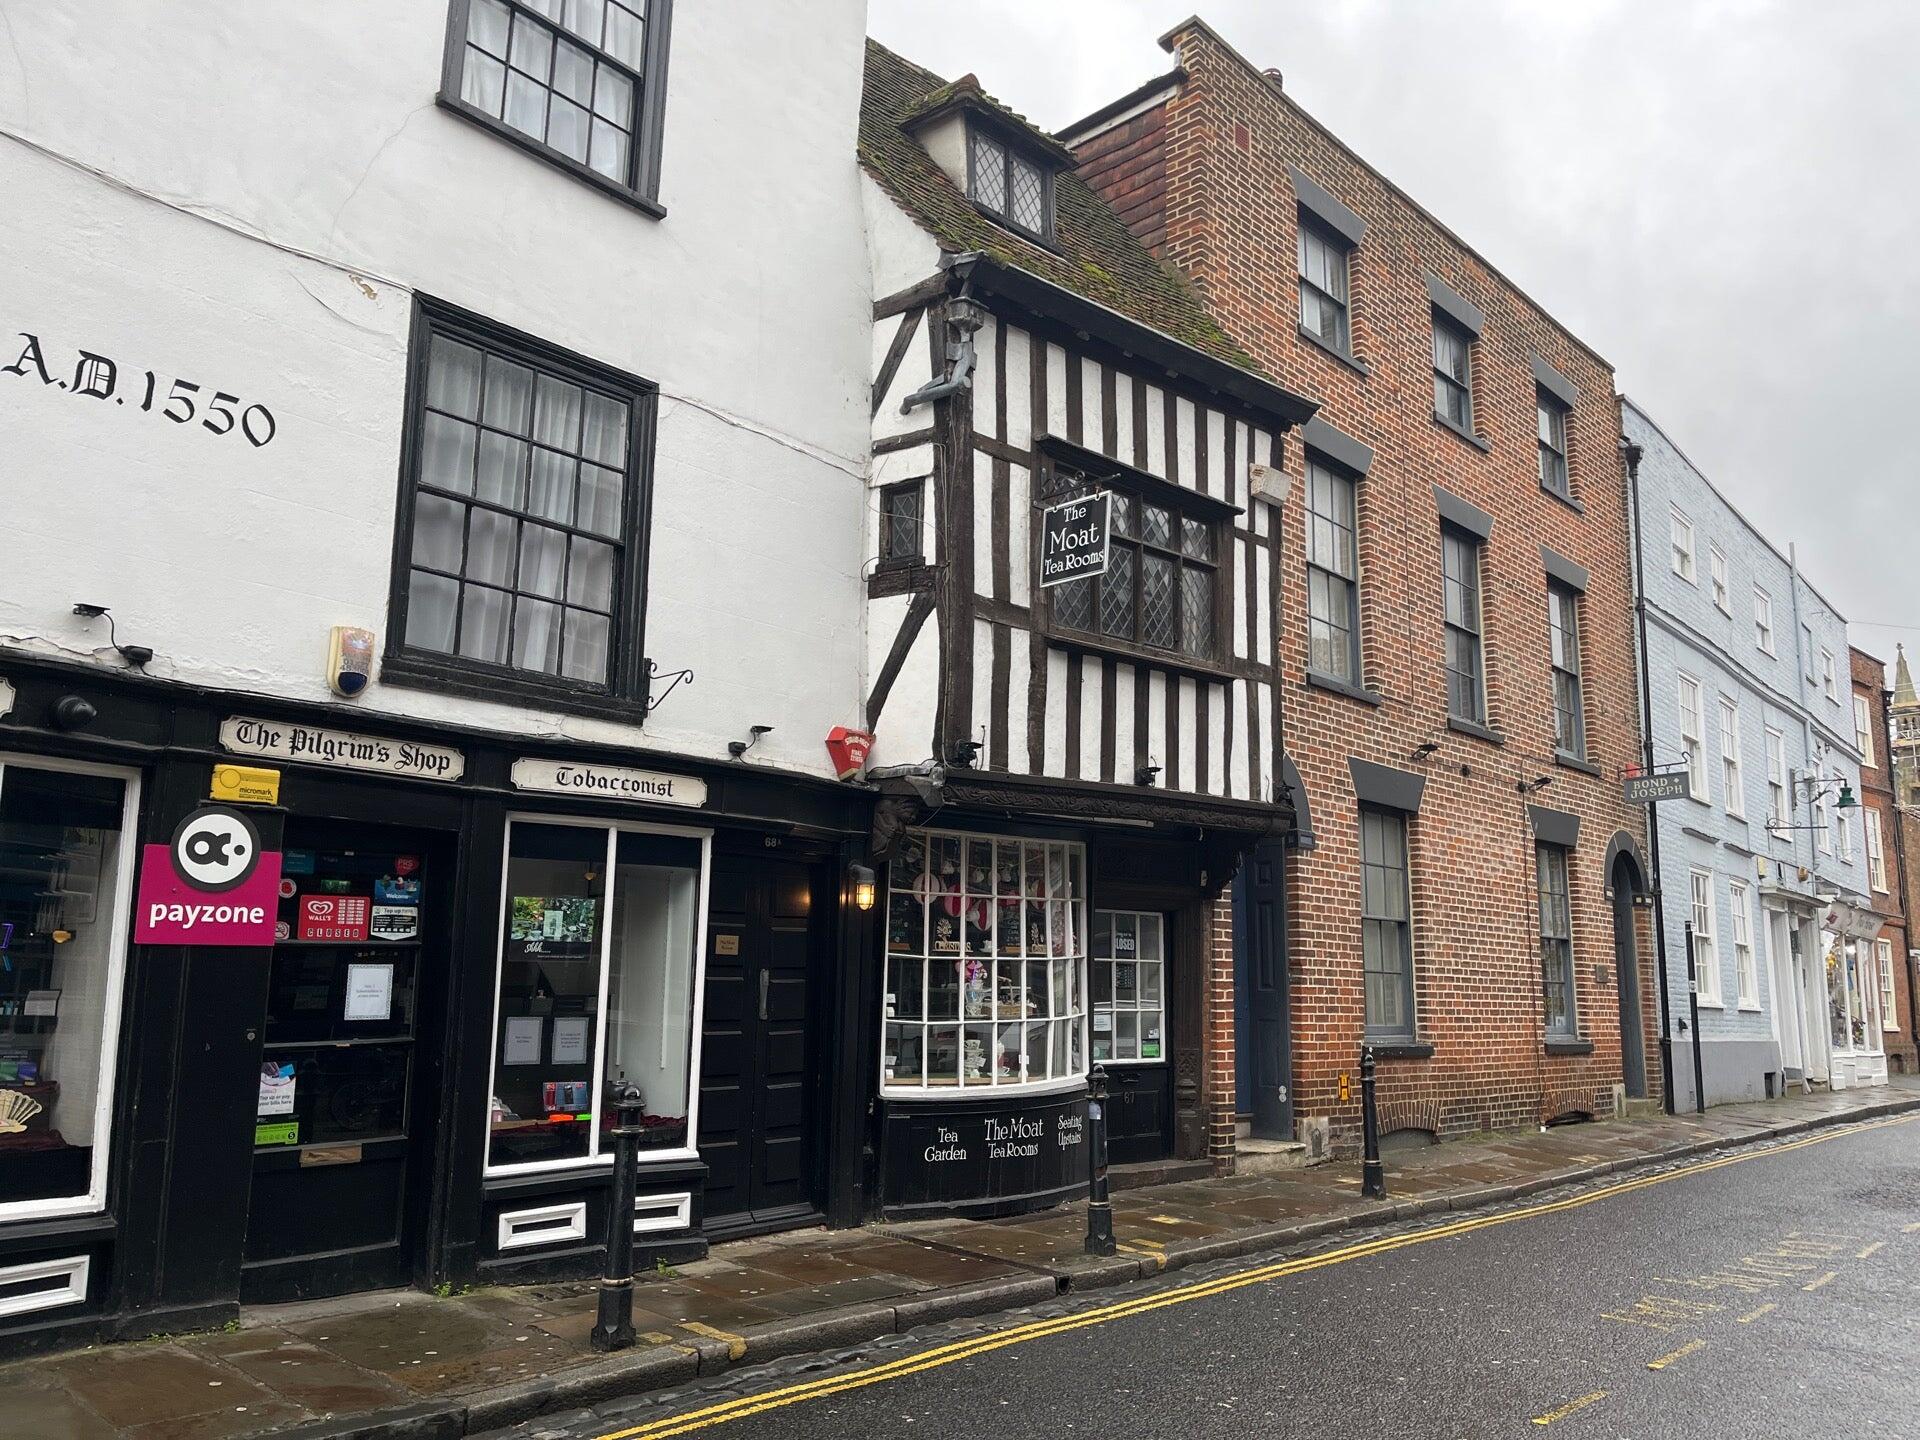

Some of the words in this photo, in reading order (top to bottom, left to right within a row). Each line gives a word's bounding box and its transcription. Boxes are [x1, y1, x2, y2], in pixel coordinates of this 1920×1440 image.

[141, 371, 276, 447] 1550
[1063, 506, 1087, 523] The
[1049, 522, 1100, 555] Moat
[1044, 558, 1063, 575] Tea
[1065, 549, 1104, 571] Rooms
[236, 720, 282, 751] The
[289, 728, 390, 762] Pilgrim's
[394, 743, 450, 775] Shop
[556, 766, 675, 798] Tobacconist
[1633, 778, 1668, 790] BOND
[1630, 785, 1683, 799] JOSEPH
[149, 903, 265, 929] payzone
[307, 928, 360, 938] CLOSED
[1116, 937, 1135, 951] LOSED
[1124, 1091, 1135, 1104] 67
[984, 1118, 1009, 1141] The
[1010, 1117, 1044, 1139] Moat
[1058, 1114, 1083, 1131] Seating
[938, 1127, 958, 1143] Tea
[1058, 1132, 1082, 1150] Upstairs
[924, 1144, 967, 1162] Garden
[988, 1142, 1006, 1159] Tea
[1006, 1142, 1039, 1157] Rooms
